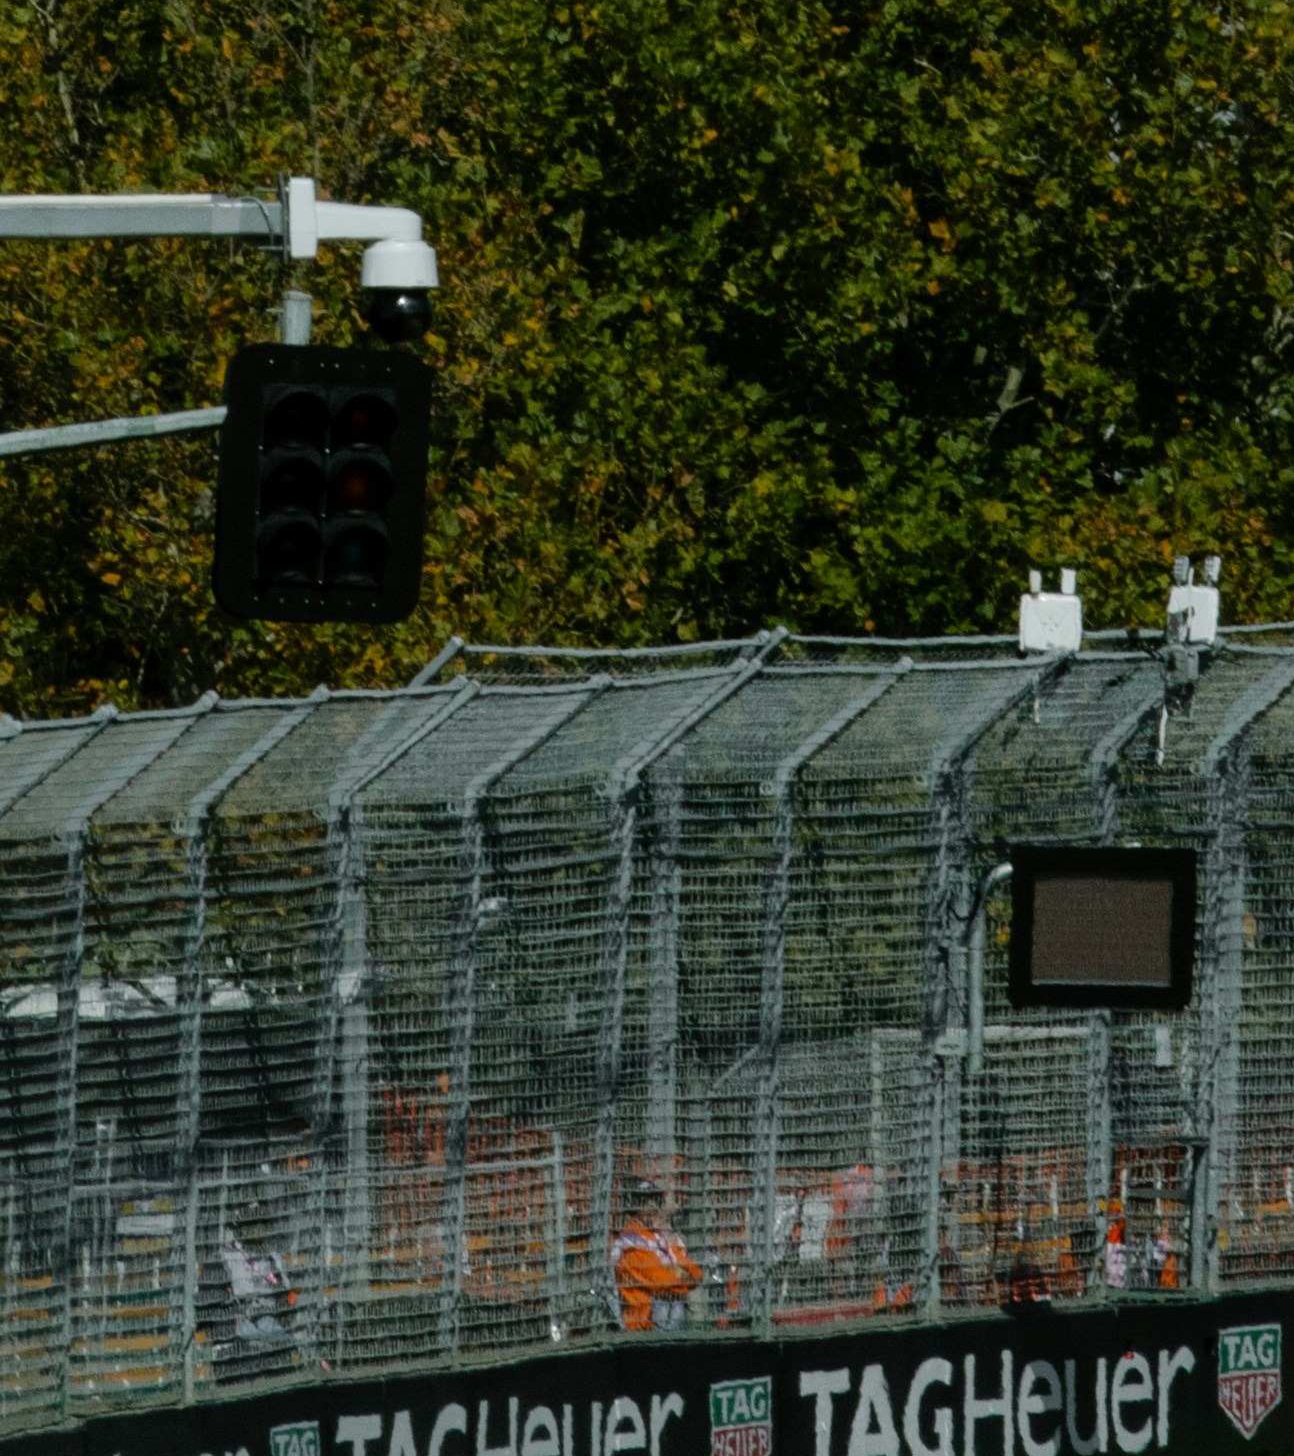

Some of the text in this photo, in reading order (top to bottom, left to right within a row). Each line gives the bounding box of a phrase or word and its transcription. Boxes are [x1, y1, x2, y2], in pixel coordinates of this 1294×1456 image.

[1223, 1331, 1276, 1369] TAG
[716, 1381, 767, 1425] TAG
[1220, 1372, 1279, 1431] HEUER
